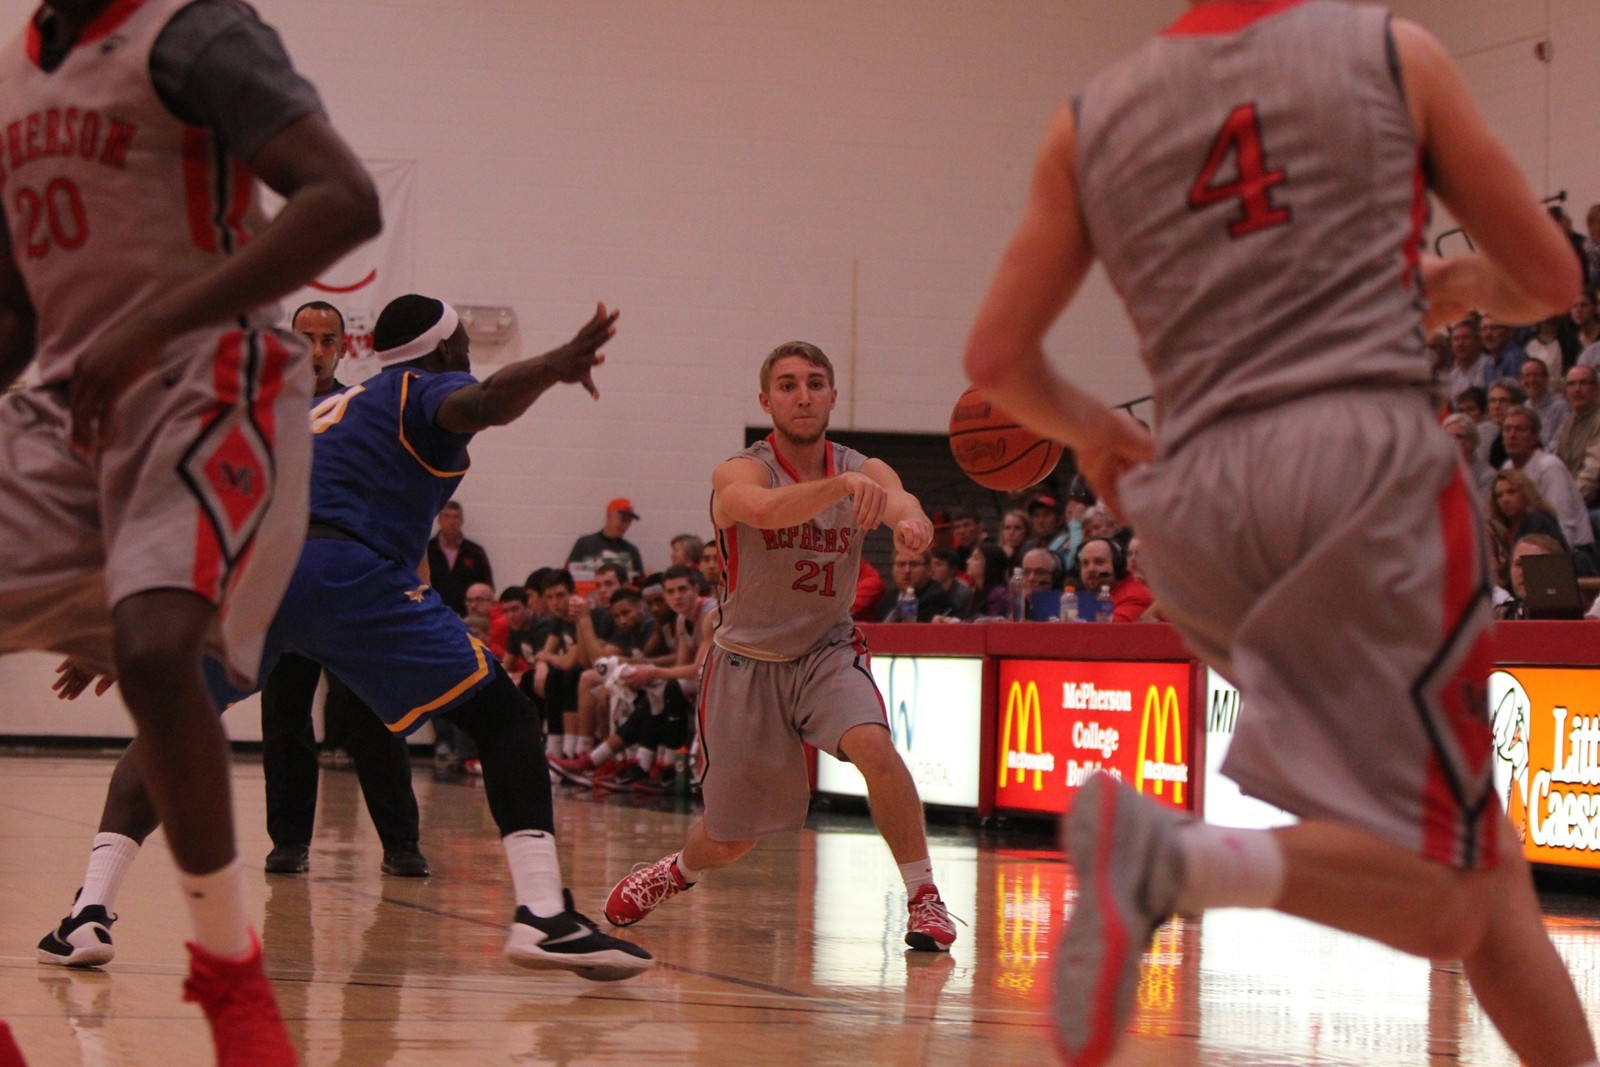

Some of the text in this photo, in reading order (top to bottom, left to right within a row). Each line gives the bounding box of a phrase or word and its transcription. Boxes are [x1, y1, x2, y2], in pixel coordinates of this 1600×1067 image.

[1186, 102, 1293, 240] 4
[14, 177, 90, 259] 20
[760, 523, 857, 554] MCPHERS
[792, 560, 836, 597] 21
[1062, 682, 1132, 712] McPherson
[1072, 721, 1119, 759] College
[1550, 706, 1600, 786] Litt
